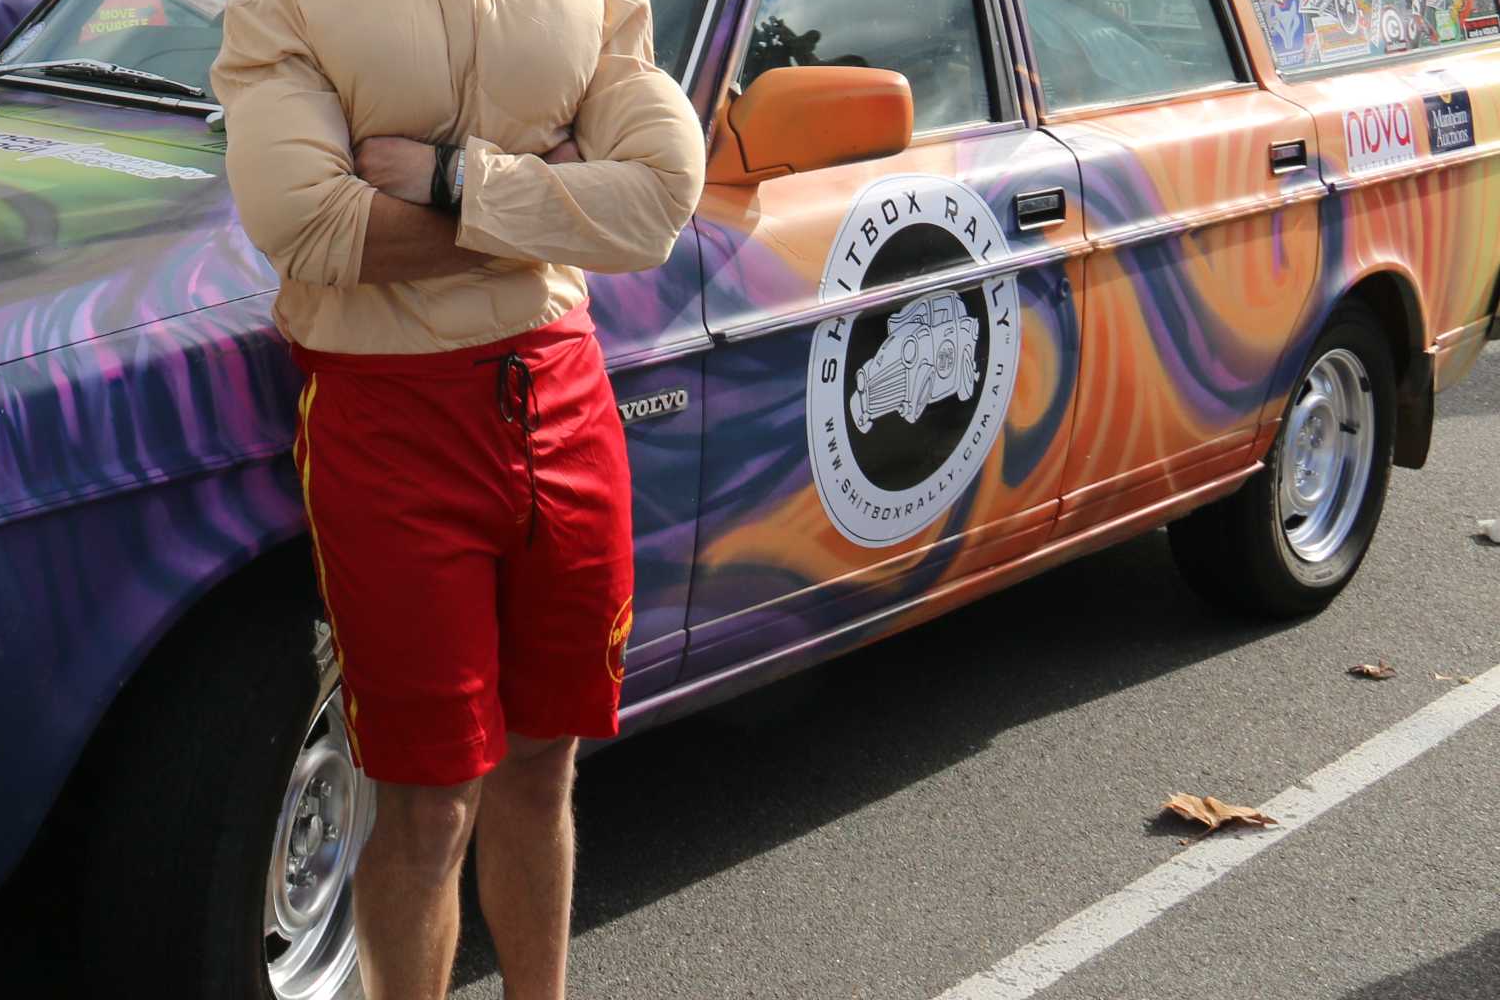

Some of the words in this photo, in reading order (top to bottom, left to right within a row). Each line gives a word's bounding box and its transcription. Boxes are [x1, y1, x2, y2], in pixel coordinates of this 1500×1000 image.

[88, 18, 149, 33] YOURSELF
[99, 8, 137, 20] MOVE
[1347, 103, 1411, 157] nova
[1432, 105, 1468, 130] Manheim
[1436, 128, 1468, 148] Auctions
[821, 190, 921, 384] SHITBOX
[944, 196, 1010, 327] RALLY
[618, 390, 688, 420] VOLVO
[821, 363, 1005, 521] WWW.SHITBOXRALLY.COM.AU
